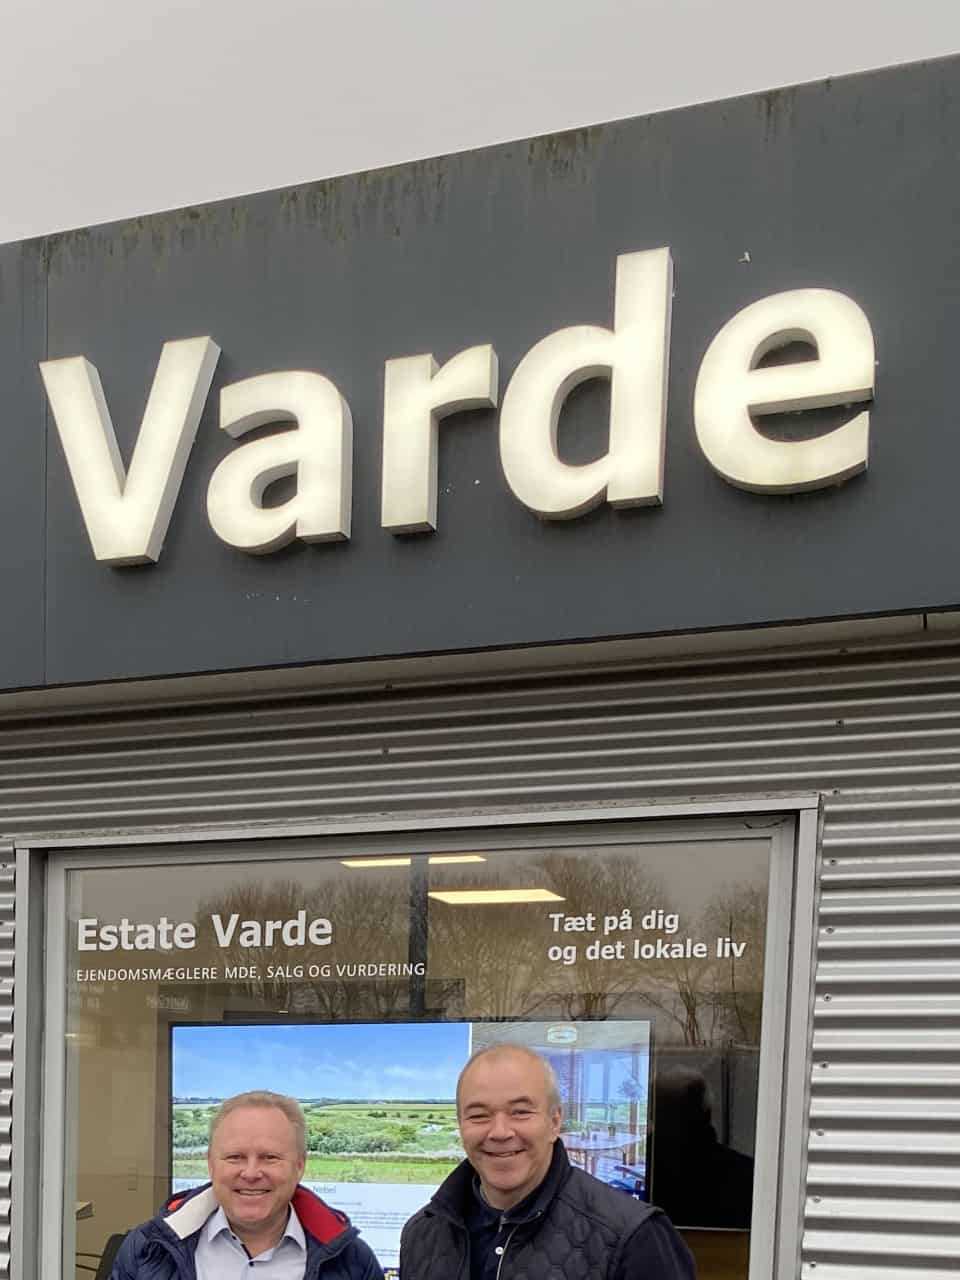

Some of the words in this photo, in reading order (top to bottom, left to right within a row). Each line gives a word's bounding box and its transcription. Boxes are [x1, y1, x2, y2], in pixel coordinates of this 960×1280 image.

[40, 245, 878, 569] Varde
[77, 917, 197, 951] Estate
[211, 910, 333, 948] Varde
[548, 912, 596, 932] Tæt
[604, 908, 633, 935] på
[641, 909, 680, 933] dig
[547, 944, 577, 965] og
[585, 940, 625, 960] det
[633, 938, 708, 959] lokale
[717, 937, 747, 958] liv
[76, 966, 217, 982] EJENDOMSMÆGLERE
[225, 965, 261, 980] MDE,
[266, 964, 304, 979] SALG
[309, 963, 331, 978] OG
[336, 962, 426, 977] VURDERING
